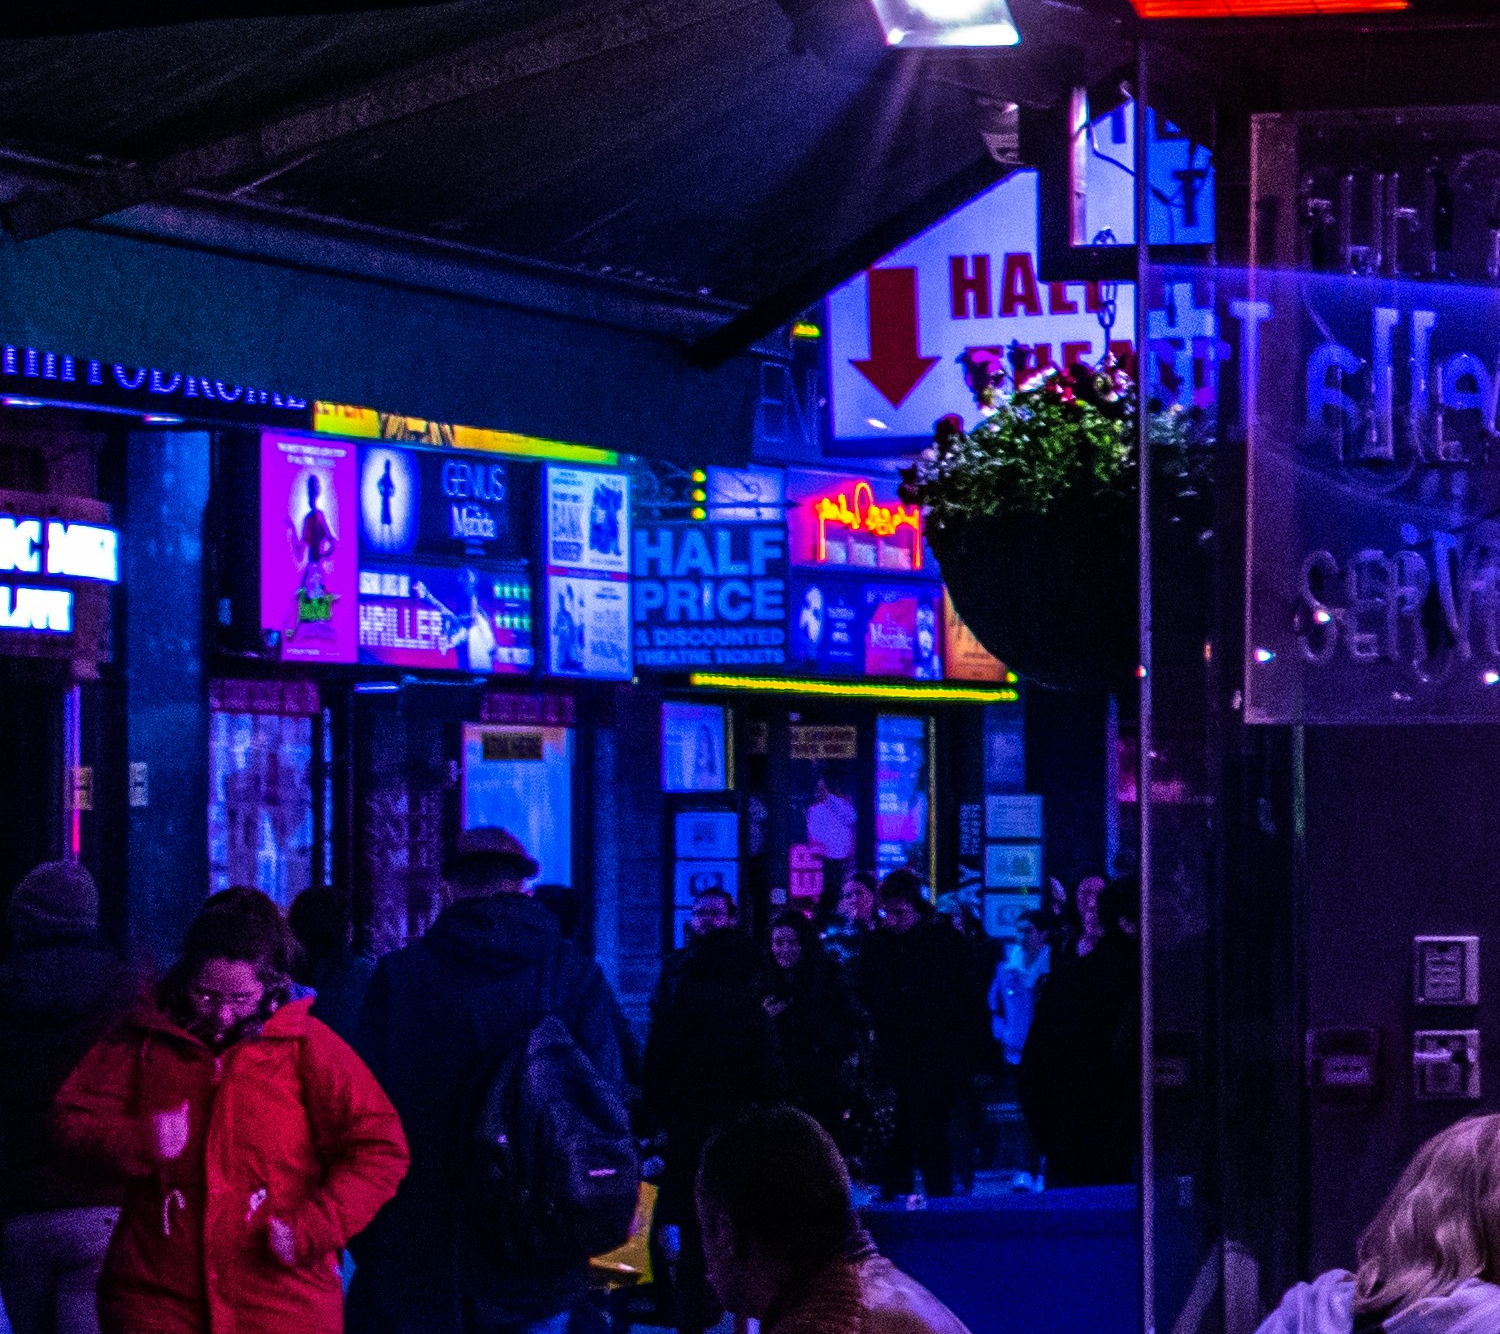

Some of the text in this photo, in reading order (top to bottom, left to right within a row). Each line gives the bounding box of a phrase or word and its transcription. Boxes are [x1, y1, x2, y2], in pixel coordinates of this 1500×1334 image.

[633, 528, 785, 576] HALF
[633, 580, 785, 621] PRICE
[652, 627, 785, 646] DISCOUNTED
[714, 648, 785, 665] TICKETS
